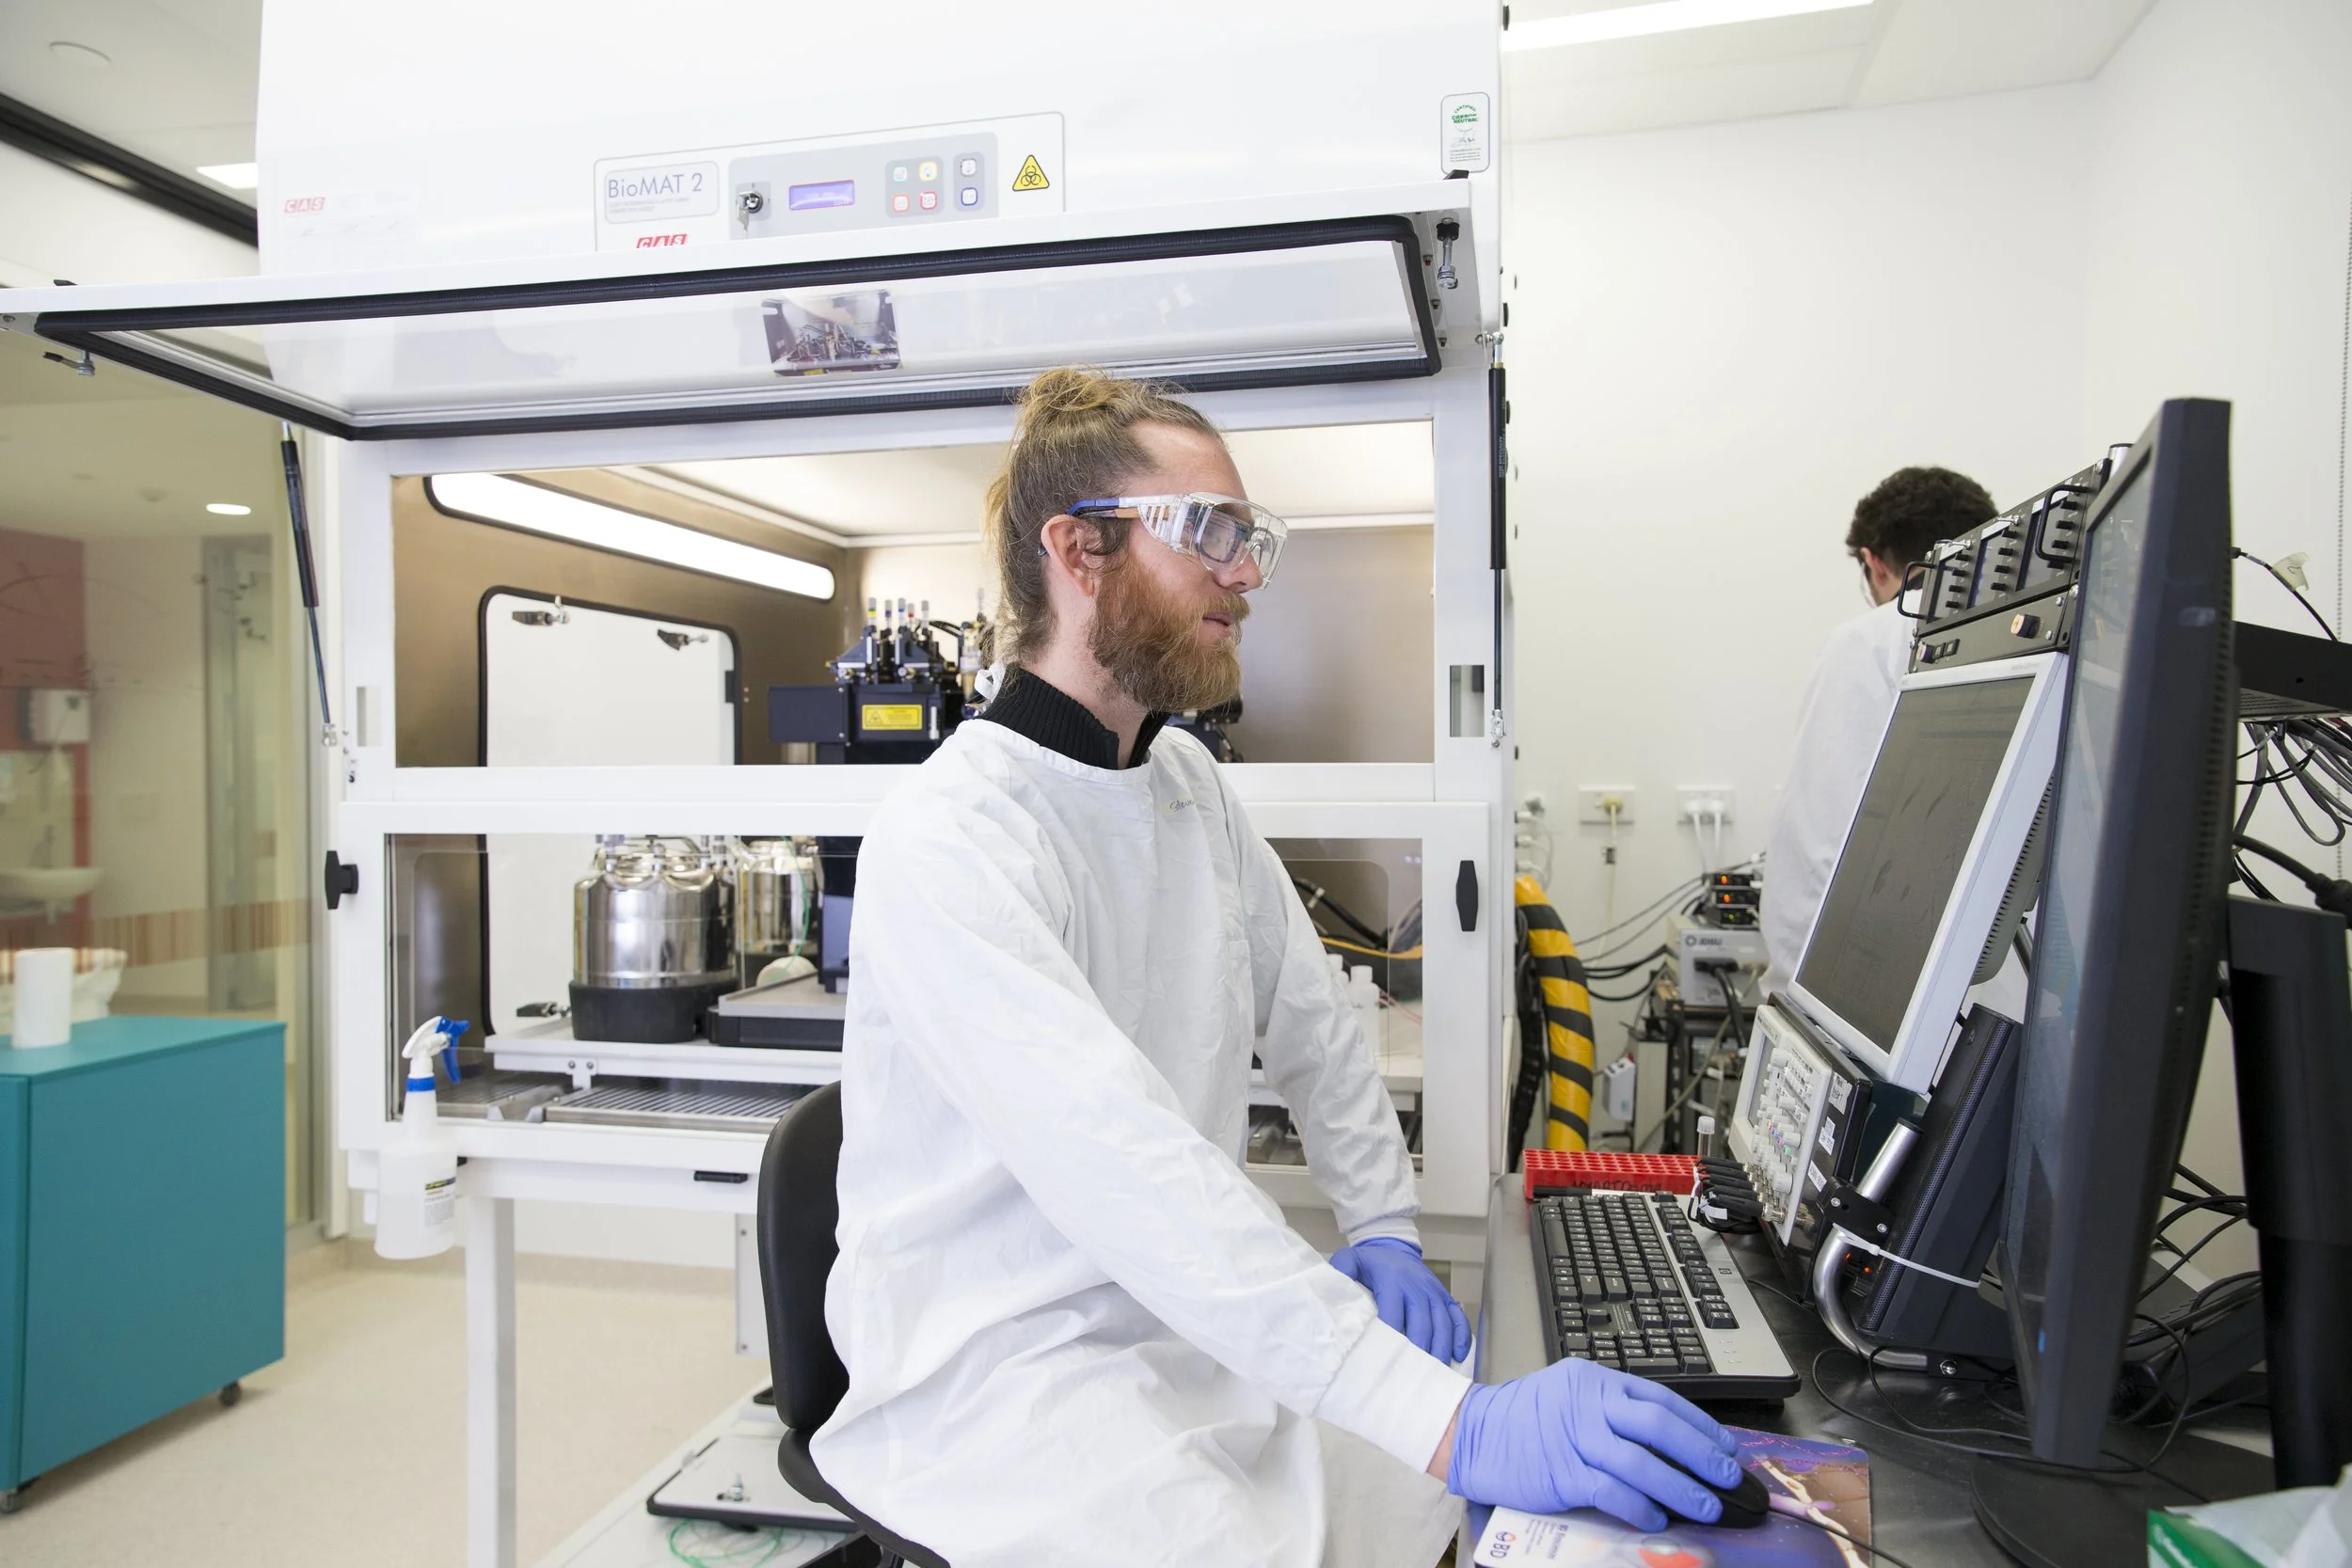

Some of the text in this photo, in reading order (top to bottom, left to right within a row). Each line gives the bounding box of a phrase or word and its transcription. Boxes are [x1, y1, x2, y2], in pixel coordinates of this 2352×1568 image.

[608, 172, 703, 198] BioMAT 2
[285, 197, 326, 213] CAS
[1490, 1543, 1510, 1559] BD
